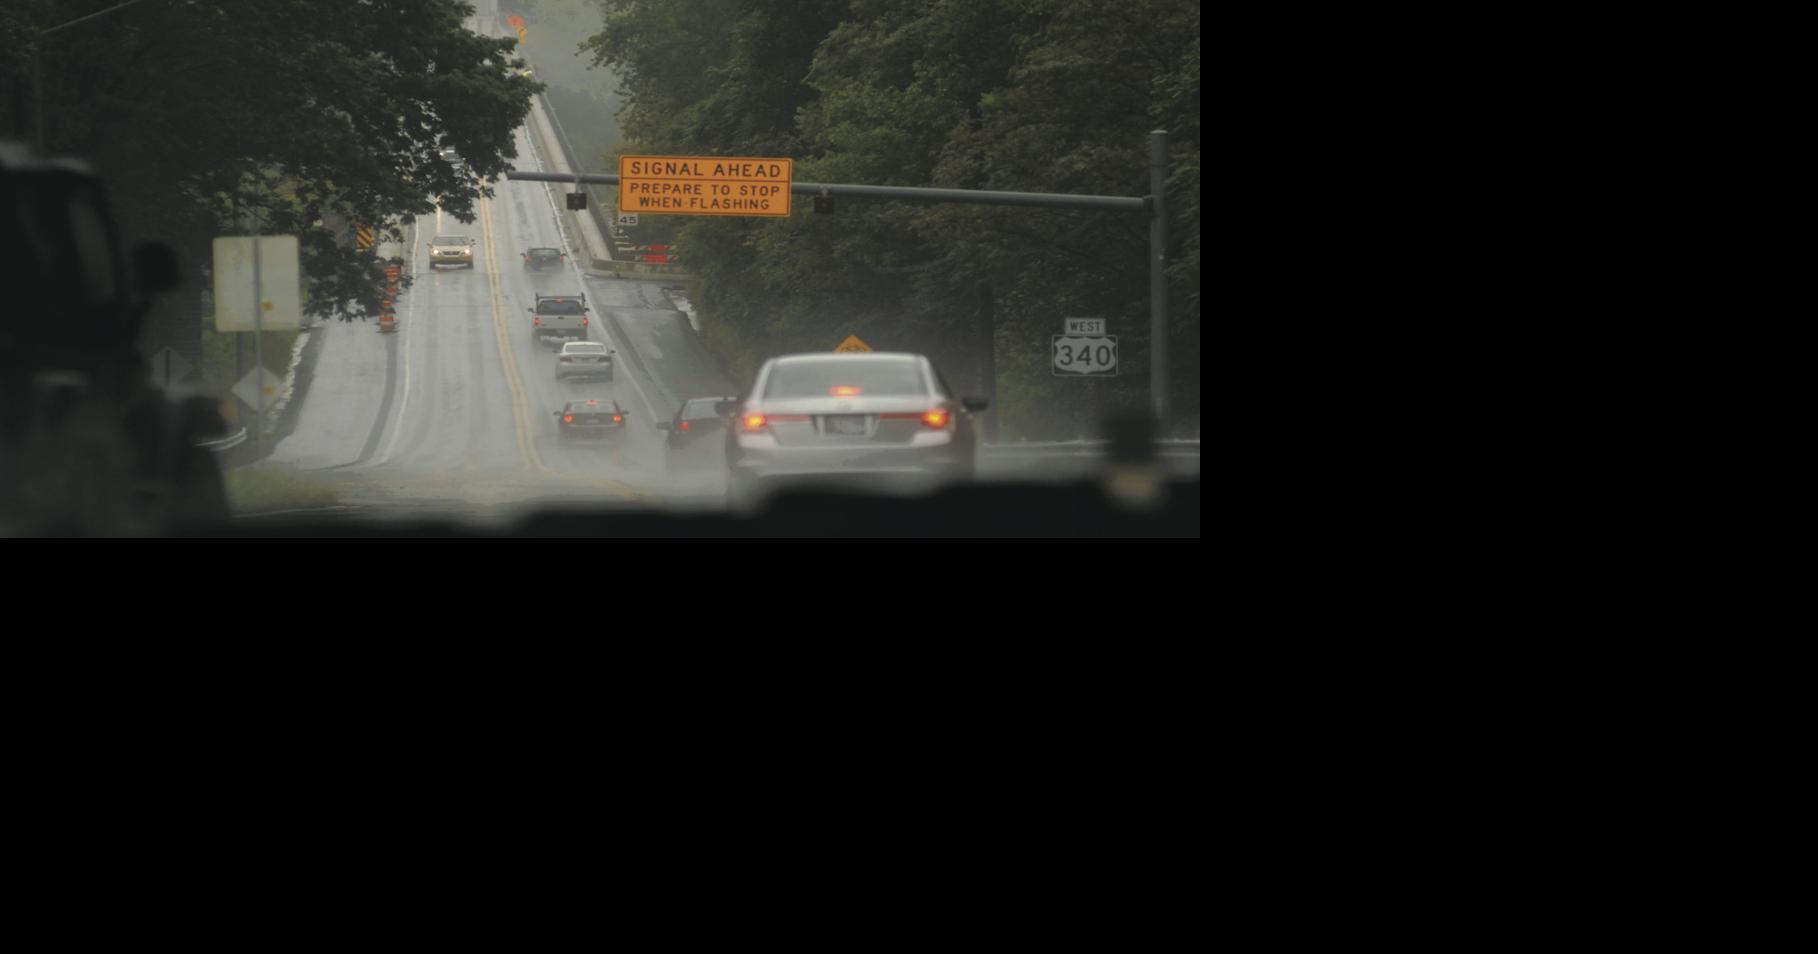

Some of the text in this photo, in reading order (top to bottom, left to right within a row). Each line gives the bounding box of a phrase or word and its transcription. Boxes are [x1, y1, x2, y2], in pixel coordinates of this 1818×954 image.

[631, 161, 781, 178] SIGNAL AHEAD
[630, 183, 780, 197] PREPARE TO STOP
[639, 197, 769, 210] WHEN FLASHING
[619, 216, 637, 224] 45
[1070, 321, 1102, 332] WEST
[1060, 345, 1110, 366] 340
